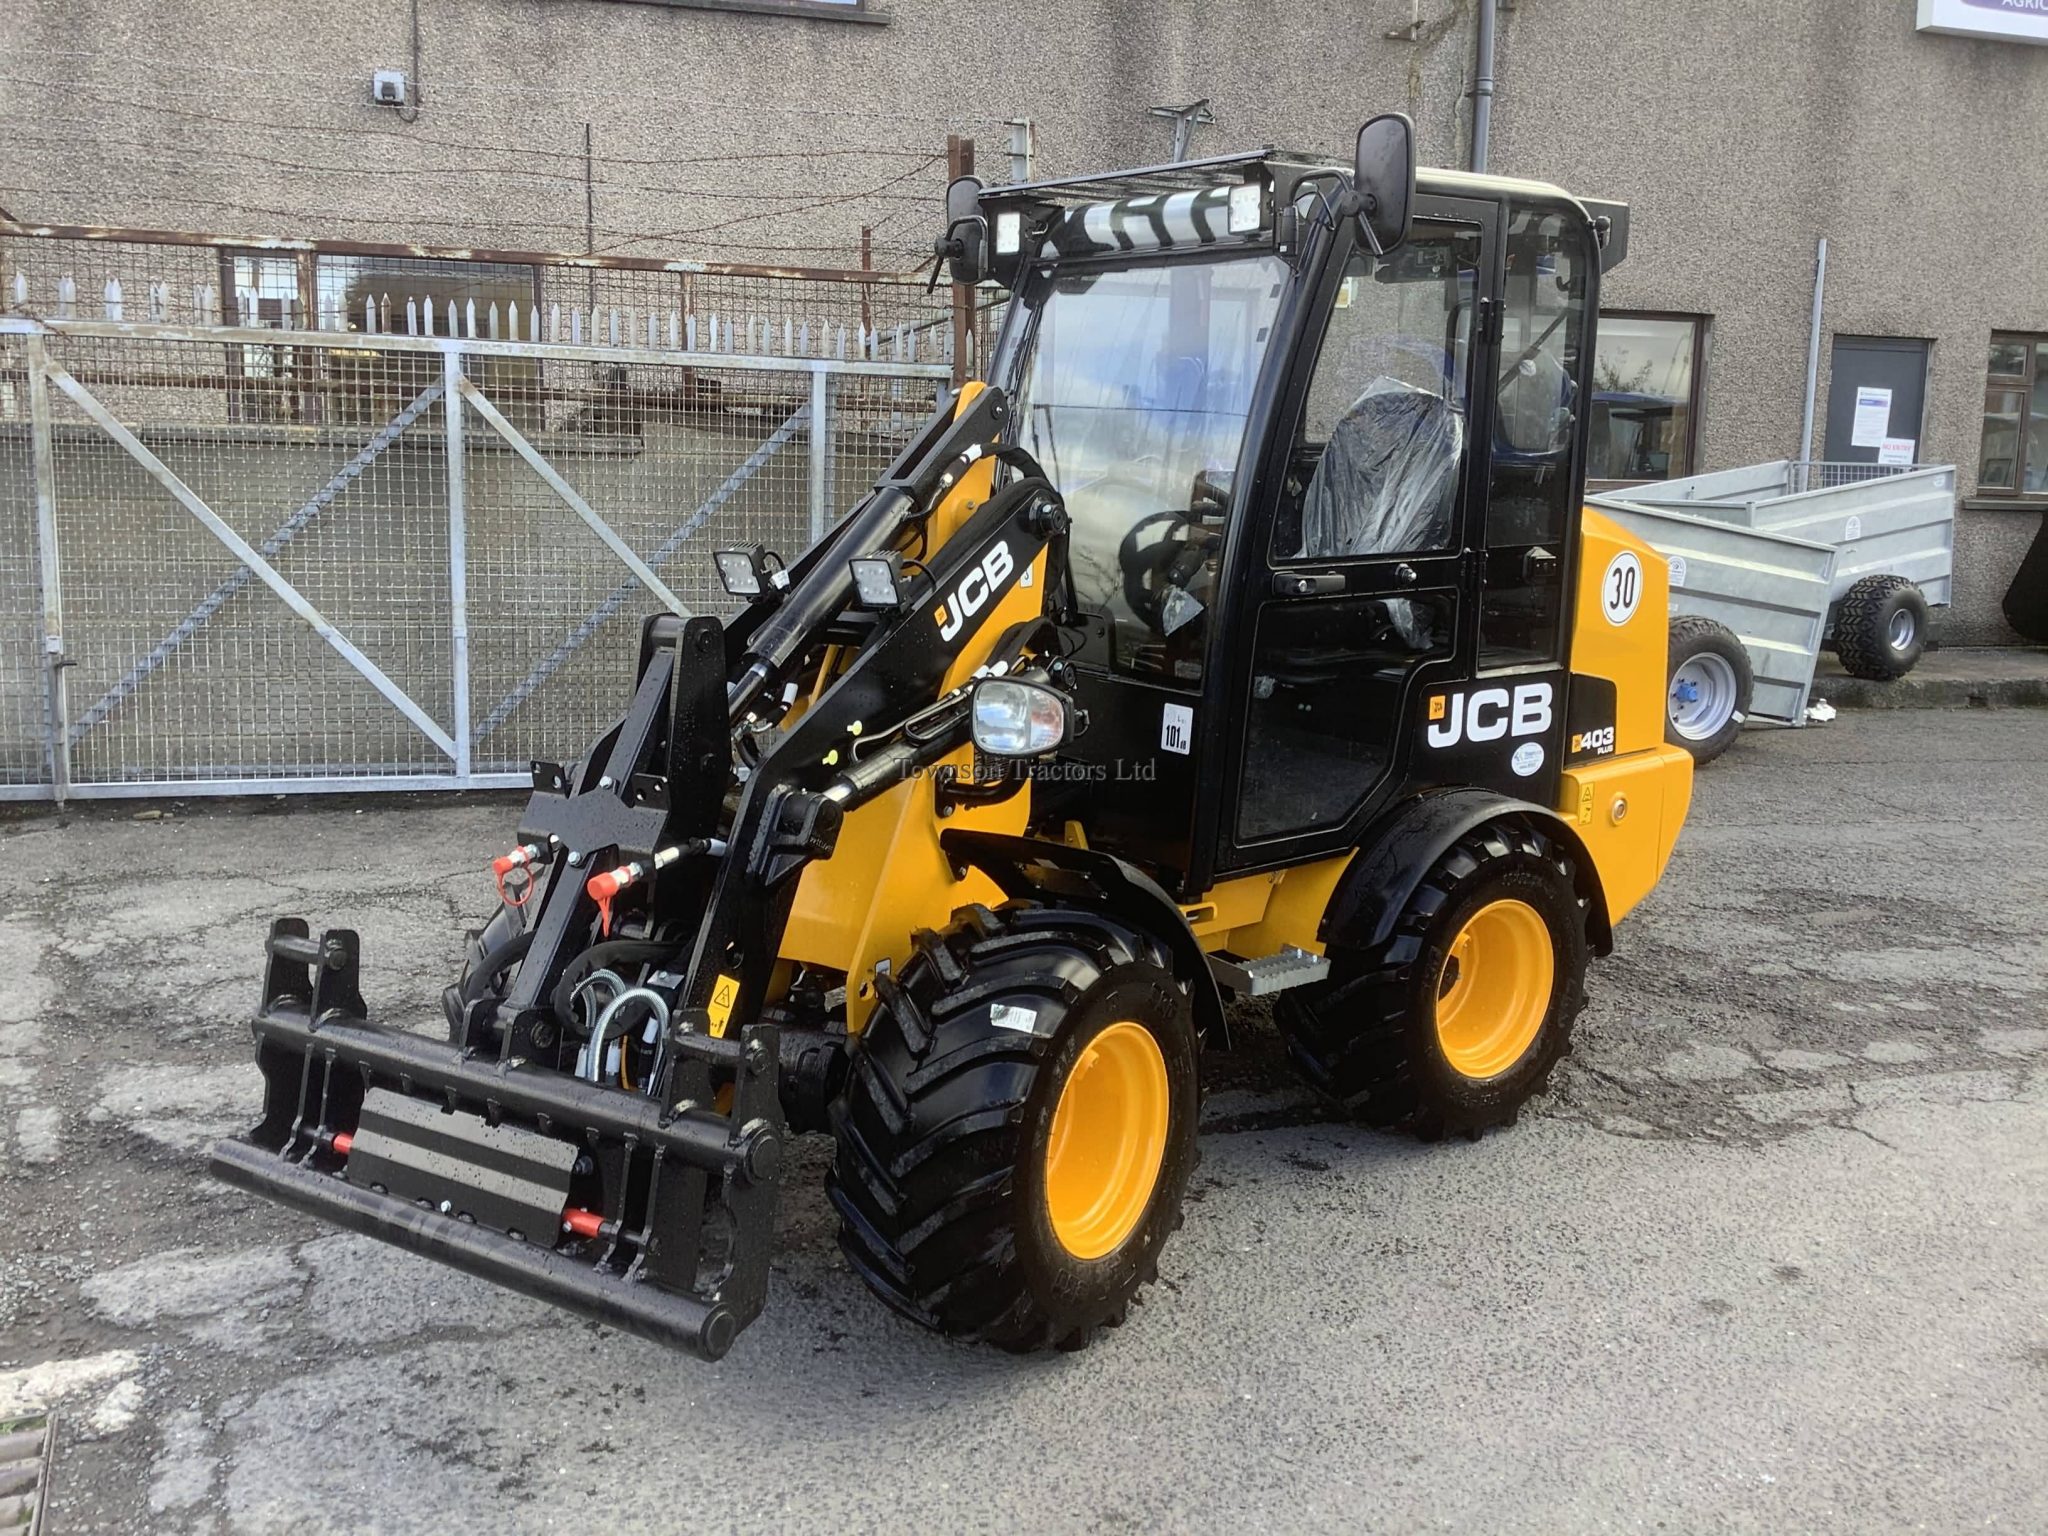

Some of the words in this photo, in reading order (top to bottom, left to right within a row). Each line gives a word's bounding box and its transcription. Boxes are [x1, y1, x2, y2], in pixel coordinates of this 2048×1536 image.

[940, 541, 1014, 642] JCB
[1610, 567, 1635, 610] 30
[1166, 725, 1180, 749] 101
[1428, 683, 1553, 748] JCB
[1581, 727, 1615, 750] 403
